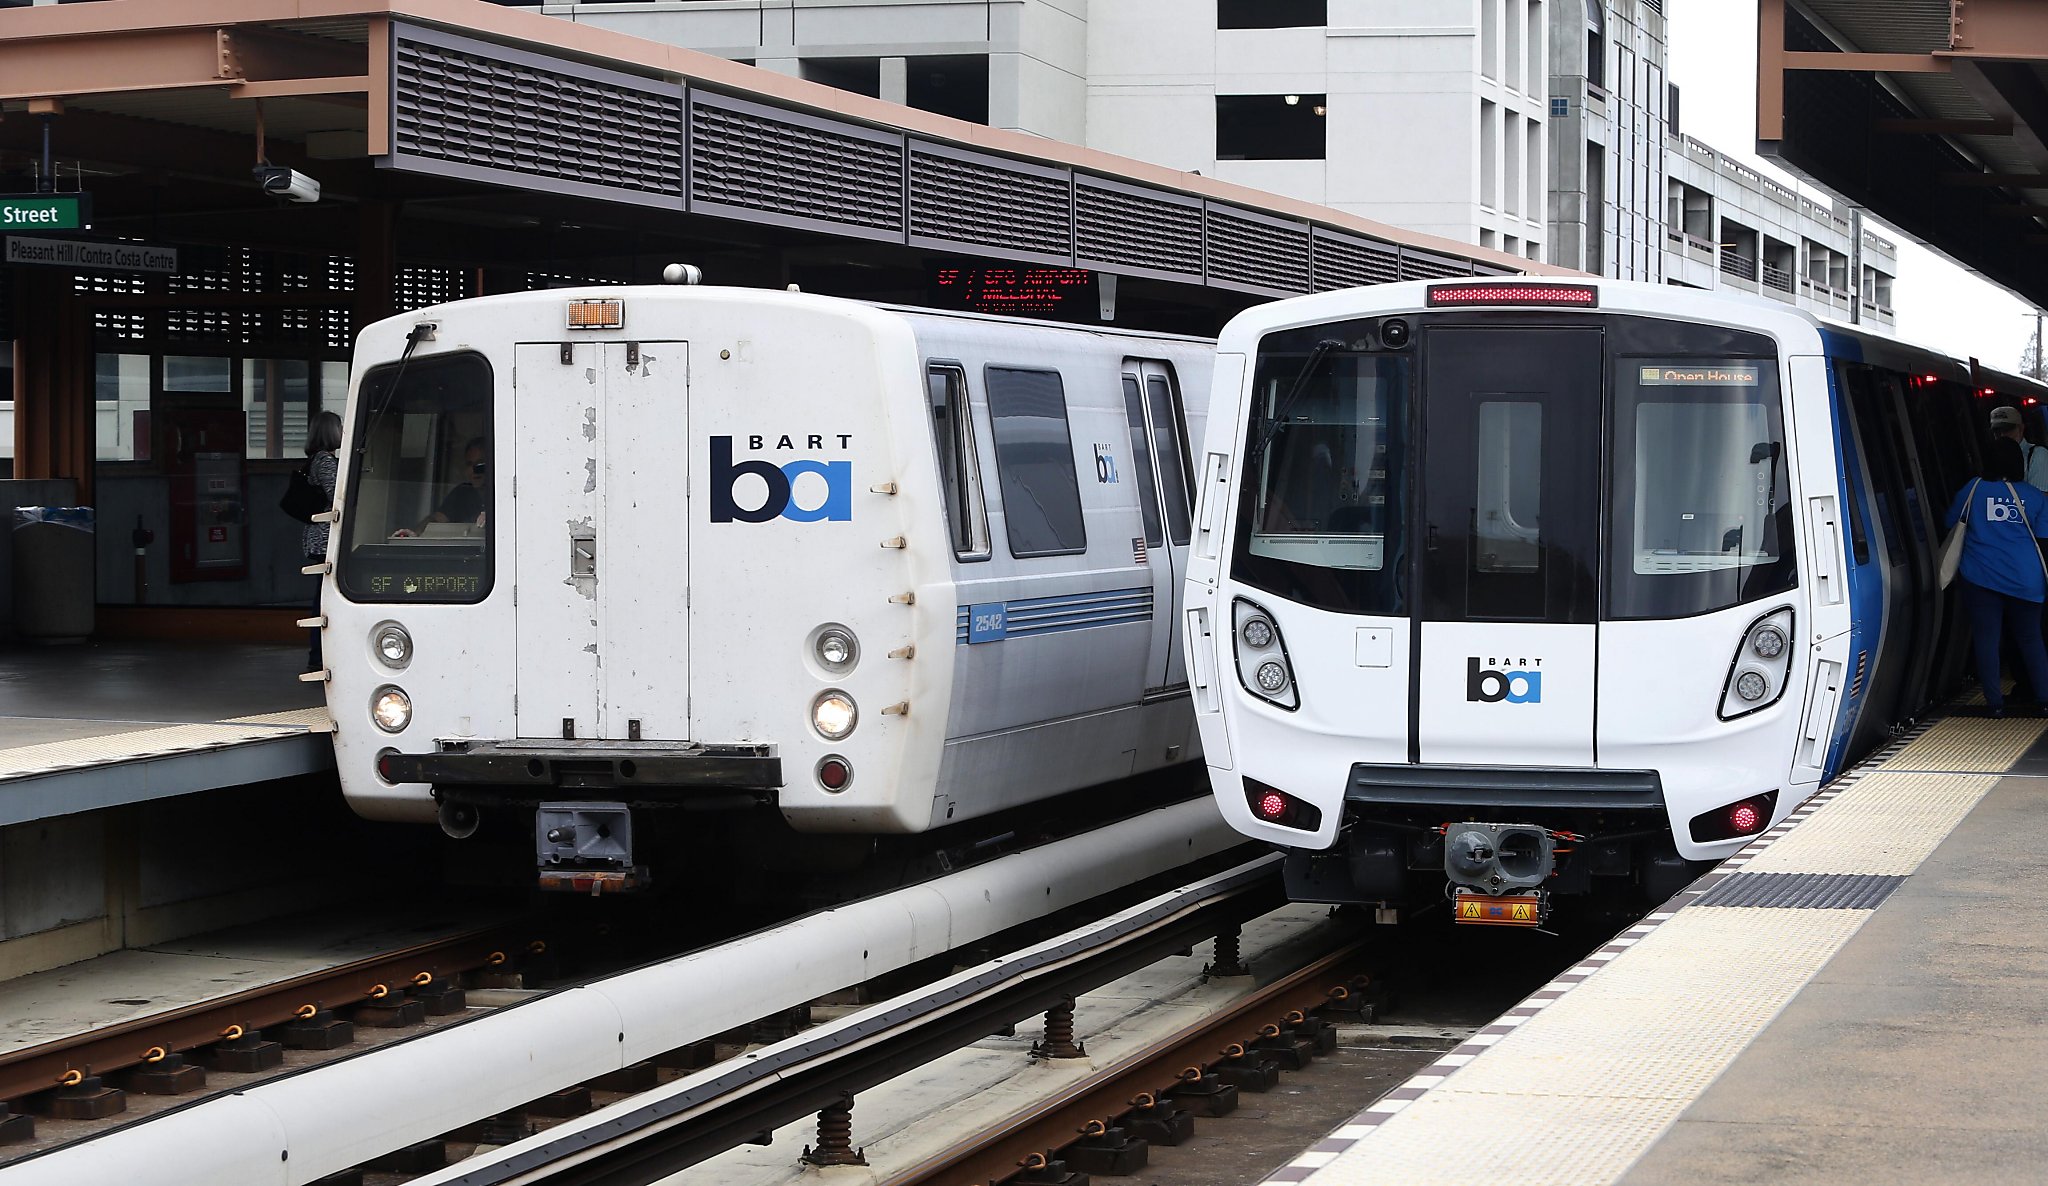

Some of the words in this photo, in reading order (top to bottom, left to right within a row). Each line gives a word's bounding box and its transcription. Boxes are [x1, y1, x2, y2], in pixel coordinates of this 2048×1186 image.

[3, 206, 58, 223] Street
[11, 240, 54, 262] Pleasant
[57, 244, 73, 262] Hill
[114, 249, 141, 267] Costa
[143, 251, 174, 269] Centre
[938, 270, 959, 285] SF
[749, 434, 852, 450] BART
[709, 435, 852, 523] ba
[371, 576, 392, 593] SF
[403, 576, 479, 593] AIRPORT
[975, 614, 1002, 632] 2542
[1488, 657, 1542, 667] BART
[1467, 657, 1542, 704] ba
